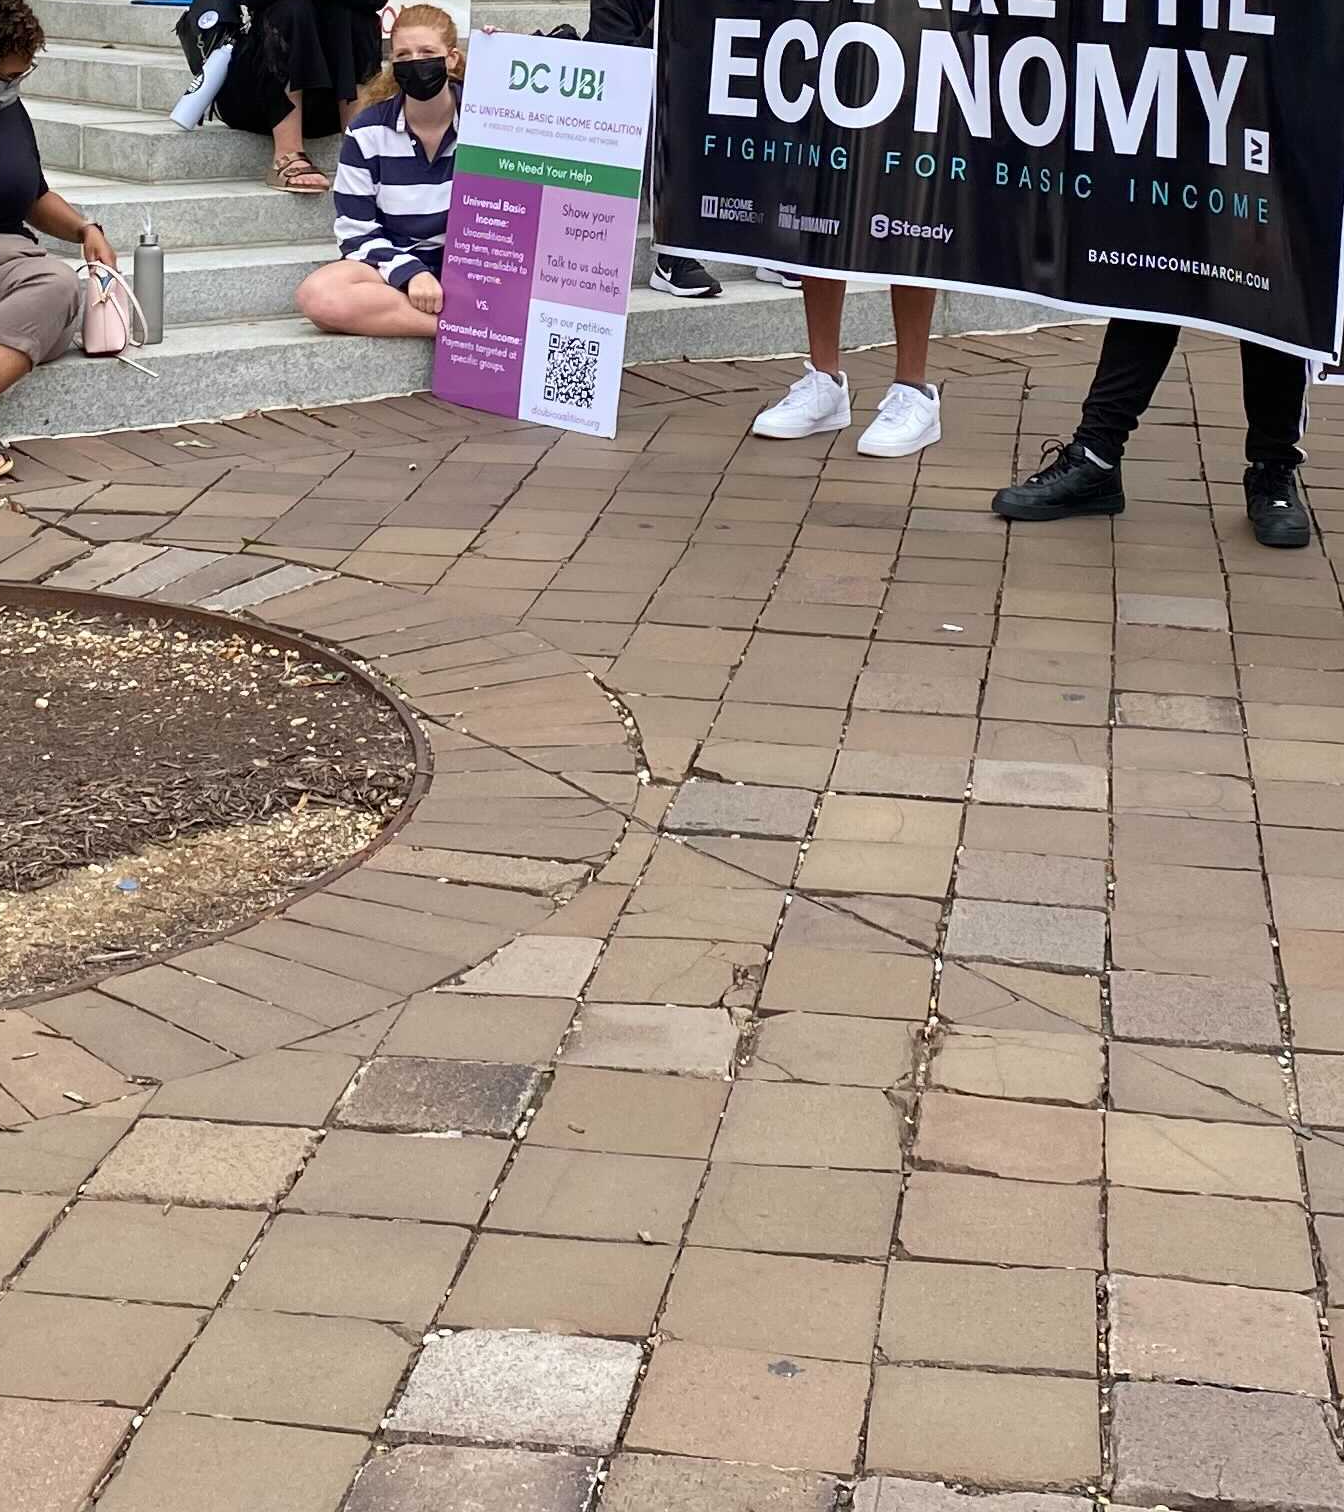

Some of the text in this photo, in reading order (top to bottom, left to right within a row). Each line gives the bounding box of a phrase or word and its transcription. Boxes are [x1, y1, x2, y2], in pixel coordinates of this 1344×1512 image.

[509, 60, 551, 94] DC
[464, 103, 643, 136] DC UNIVERSAL BASIC INCOME COALITION
[499, 158, 593, 186] We Need Your Help
[704, 134, 1270, 224] FIGHTING FOR BASIC INCOME
[463, 194, 526, 214] Universal Basic
[719, 197, 754, 210] INCOME
[562, 204, 616, 225] Show your
[719, 208, 765, 224] MOVEMENT
[565, 226, 608, 241] support!
[891, 220, 953, 243] Steady
[547, 255, 618, 278] Talk to us about
[1088, 249, 1270, 291] BASICINCOMEMARCH.COM
[540, 269, 558, 283] how
[561, 277, 577, 290] you
[579, 280, 596, 289] can
[439, 320, 488, 338] Guaranteed
[540, 313, 558, 328] Sign
[560, 318, 574, 328] our
